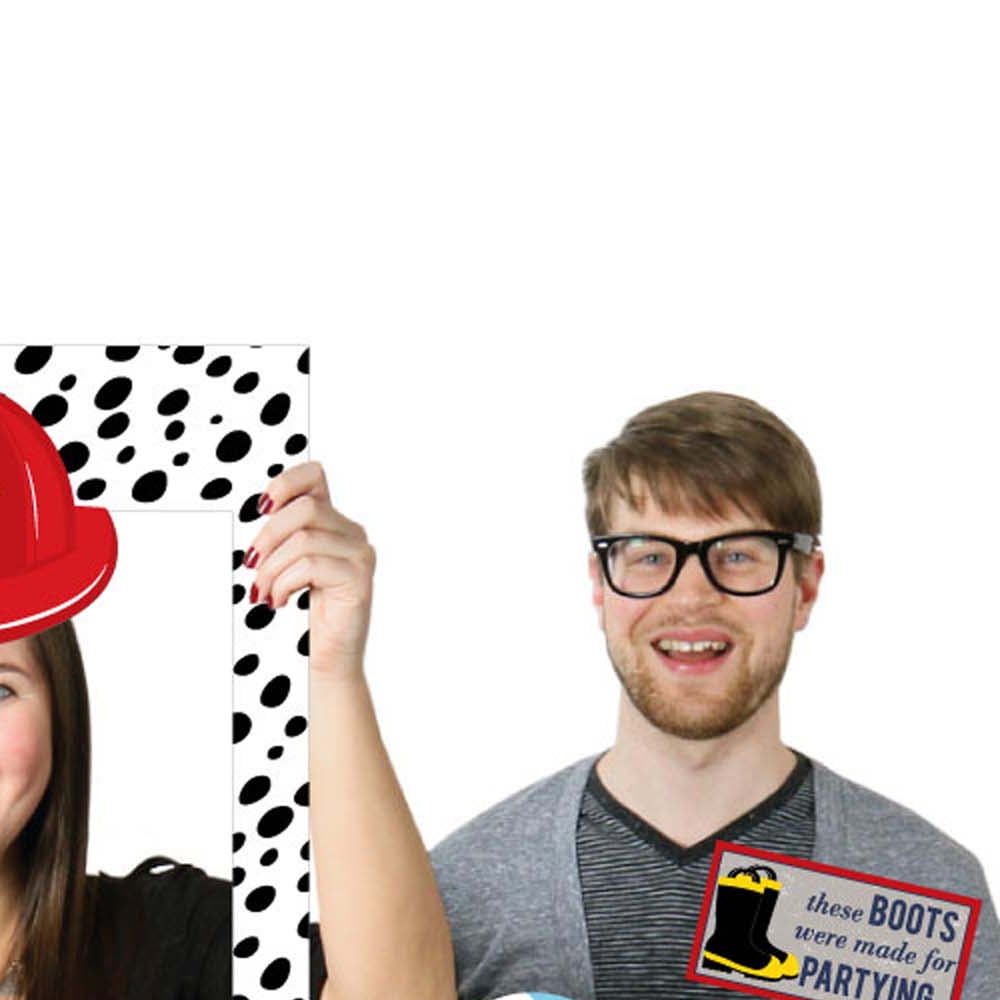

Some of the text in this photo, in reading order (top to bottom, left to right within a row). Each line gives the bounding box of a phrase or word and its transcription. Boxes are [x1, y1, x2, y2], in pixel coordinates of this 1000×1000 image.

[806, 892, 959, 943] these BOOTS
[794, 923, 958, 975] were made for
